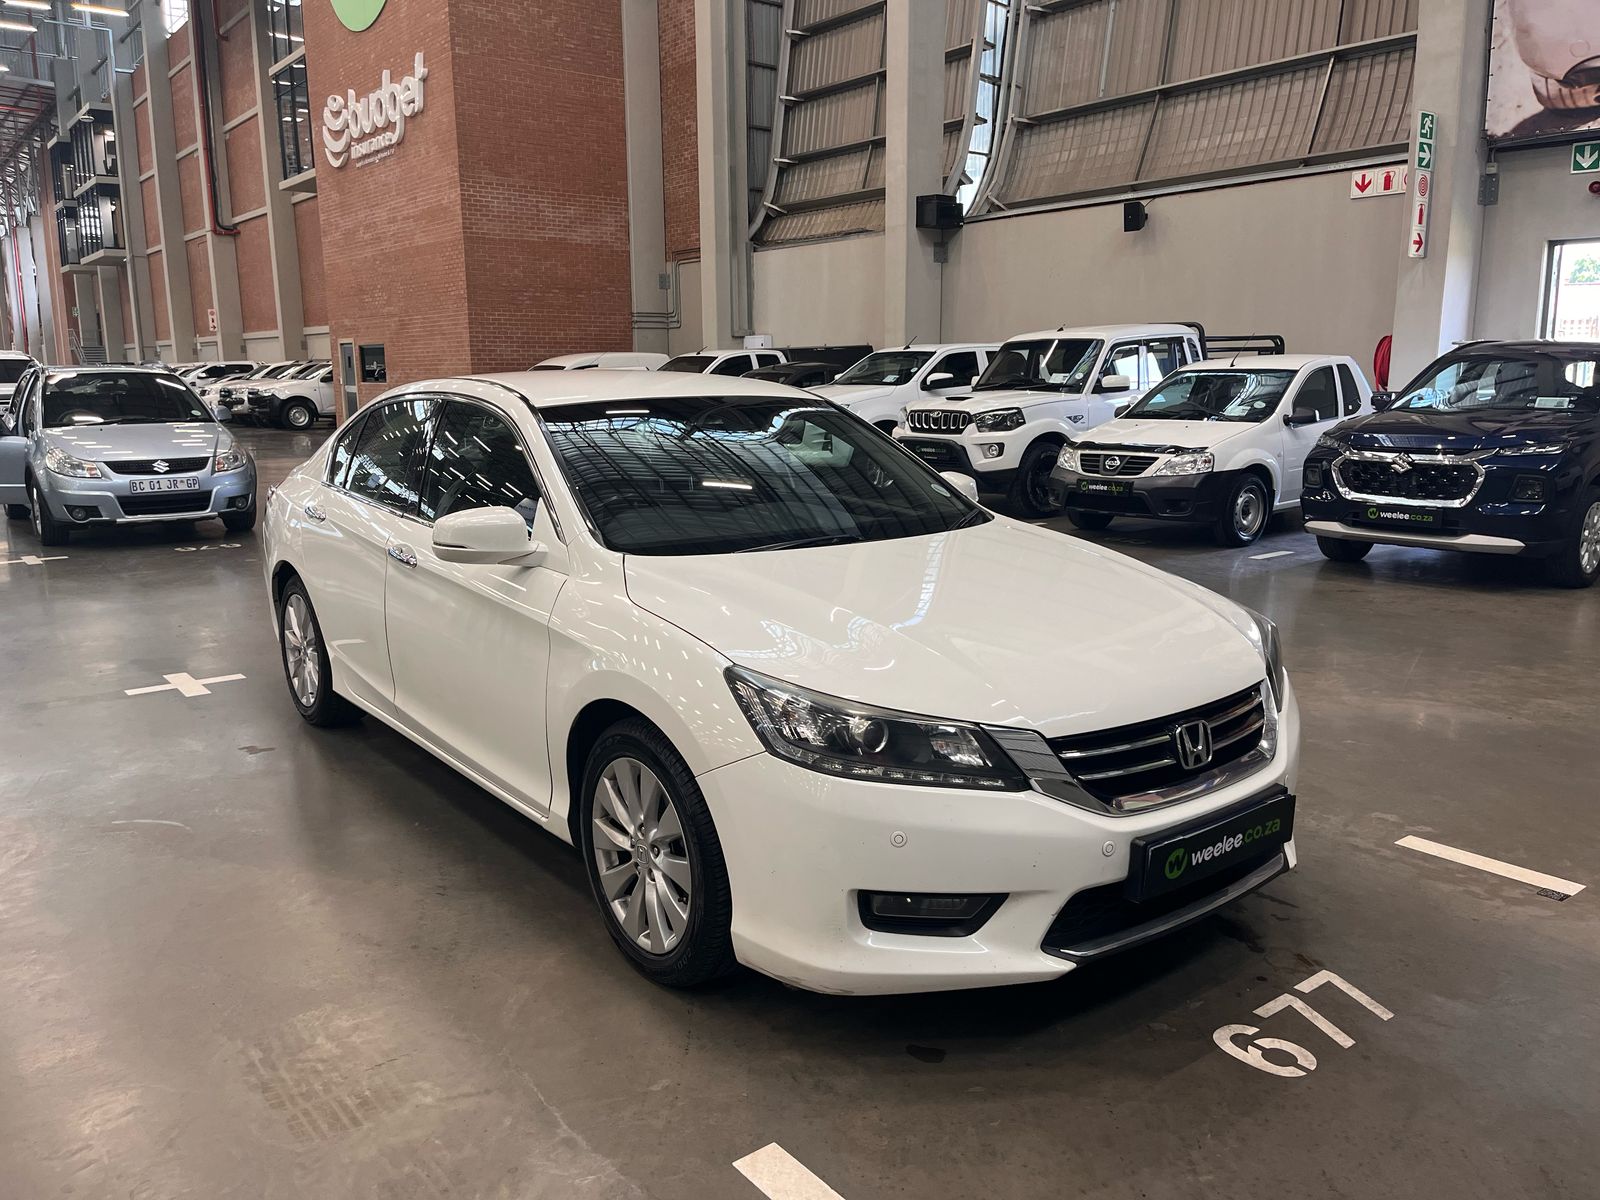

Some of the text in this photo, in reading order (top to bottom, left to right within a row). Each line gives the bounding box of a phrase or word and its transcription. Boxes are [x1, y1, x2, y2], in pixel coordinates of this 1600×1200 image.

[347, 51, 429, 145] budget
[131, 478, 198, 492] BC 01 JR GP
[1380, 511, 1433, 522] weelee.co.za
[1191, 818, 1281, 866] weelee.co.za
[1212, 969, 1396, 1078] 677
